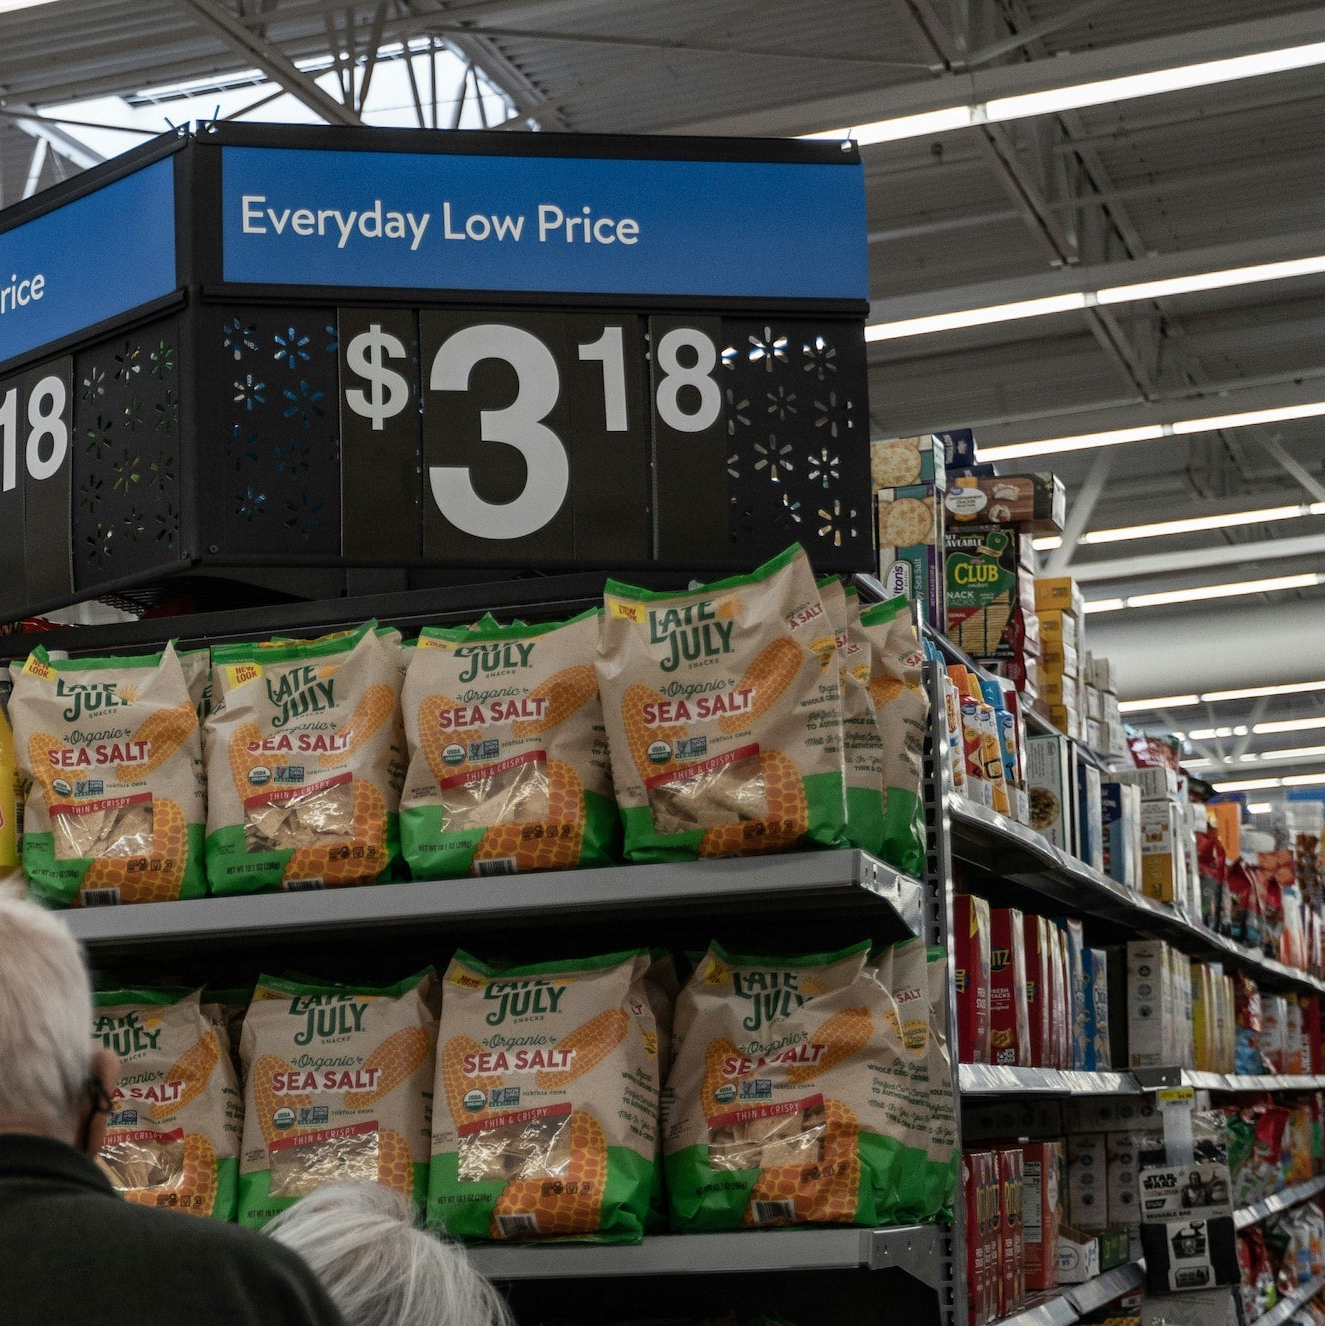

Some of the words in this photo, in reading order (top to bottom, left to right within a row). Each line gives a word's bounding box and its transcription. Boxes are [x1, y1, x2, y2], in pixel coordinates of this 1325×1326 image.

[241, 196, 430, 251] Everyday
[443, 202, 525, 241] Low
[537, 204, 639, 246] Price
[954, 563, 999, 584] CLUB
[649, 600, 715, 644] LATE
[660, 621, 734, 673] JULY
[29, 665, 49, 678] LOOK
[235, 666, 254, 675] NEW
[459, 643, 536, 683] JULY
[236, 671, 258, 683] LOOK
[266, 664, 318, 707] LATE
[463, 686, 519, 704] Organic
[668, 678, 726, 700] Organic
[89, 709, 117, 719] SNACKS
[439, 705, 485, 728] SEA
[490, 698, 546, 722] SALT
[643, 701, 691, 724] SEA
[696, 689, 752, 719] SALT
[70, 728, 123, 748] Organic
[298, 732, 350, 752] SALT
[48, 745, 91, 767] SEA
[96, 741, 148, 765] SALT
[673, 770, 694, 781] THIN
[705, 752, 736, 770] CRISPY
[72, 806, 90, 814] THIN
[101, 797, 131, 808] CRISPY
[734, 972, 798, 998] LATE
[486, 986, 565, 1026] JULY
[294, 1002, 366, 1045] JULY
[490, 1033, 548, 1051] Organic
[298, 1053, 354, 1069] Organic
[463, 1052, 510, 1074] SEA
[515, 1049, 573, 1070] SALT
[272, 1071, 319, 1092] SEA
[323, 1068, 379, 1091] SALT
[484, 1119, 506, 1130] THIN
[517, 1108, 548, 1123] CRISPY
[293, 1135, 314, 1146] THIN
[325, 1127, 356, 1140] CRISPY
[1143, 1180, 1177, 1191] WARS
[1145, 1173, 1177, 1184] STAR
